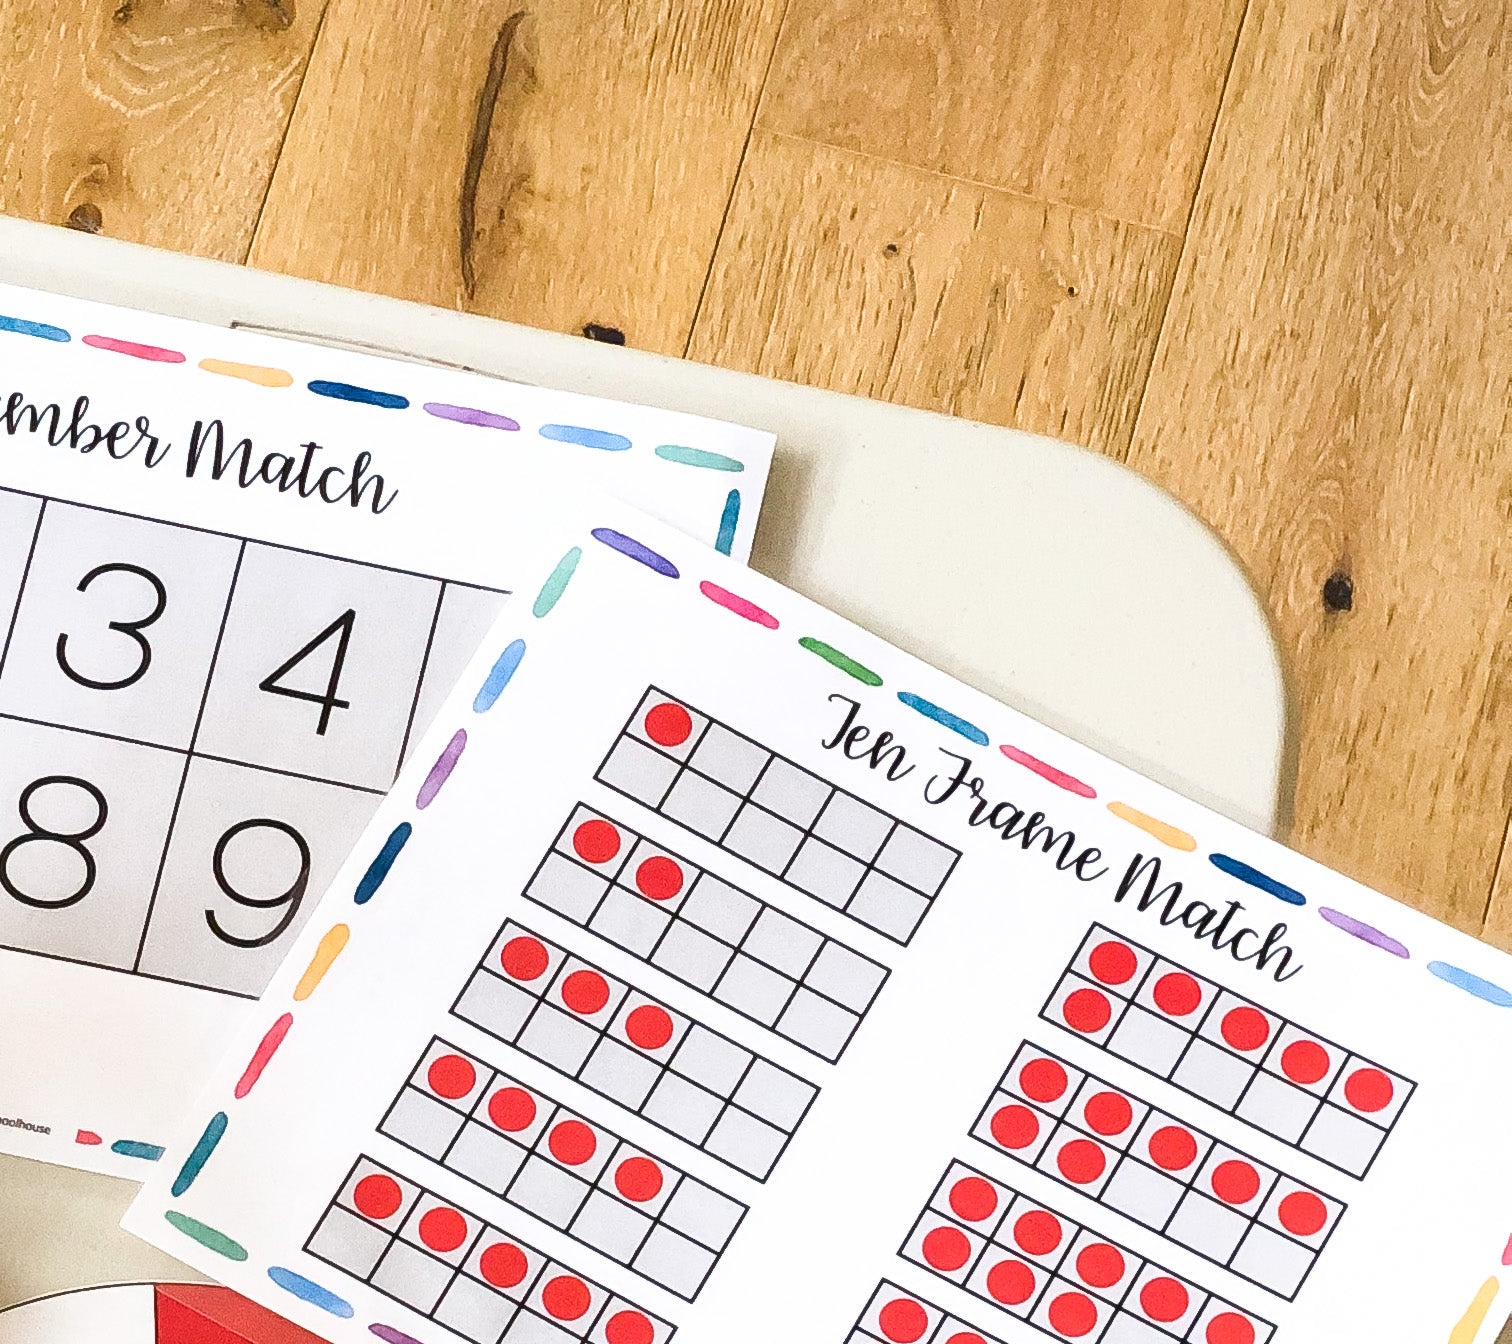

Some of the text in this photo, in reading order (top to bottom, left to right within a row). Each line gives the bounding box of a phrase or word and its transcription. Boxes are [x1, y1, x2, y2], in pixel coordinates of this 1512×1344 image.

[186, 420, 399, 514] Match
[56, 562, 167, 691] 3
[258, 608, 356, 737] 4
[204, 818, 311, 949] 9
[820, 693, 1303, 982] Ten Frame Match
